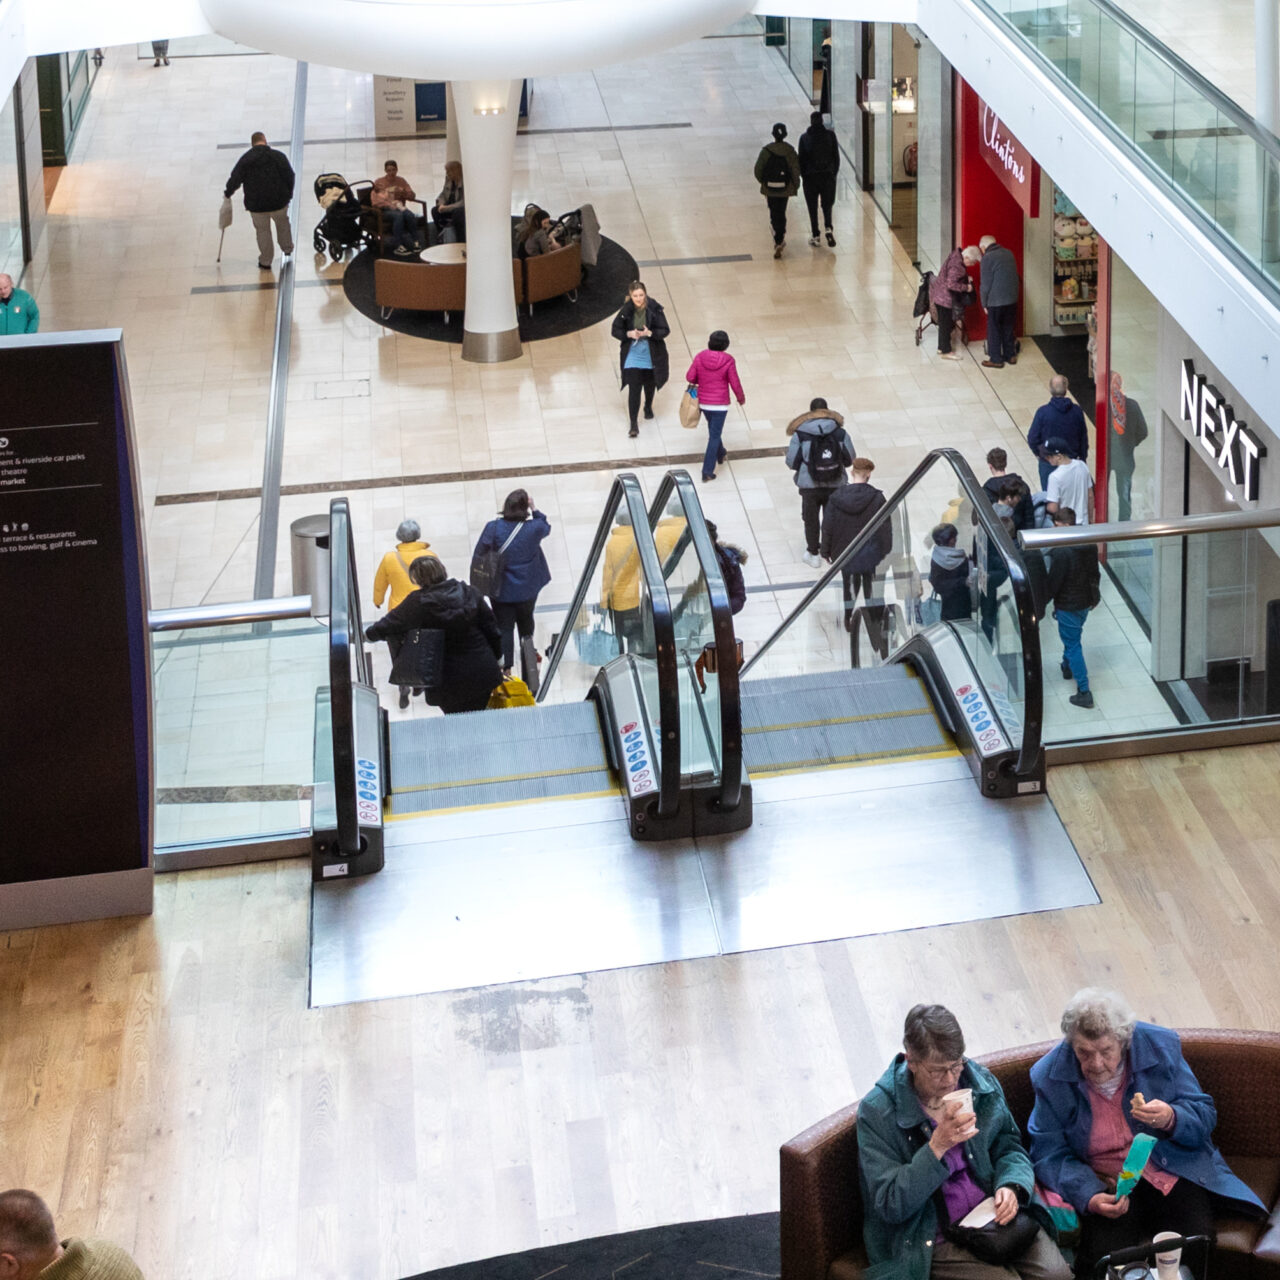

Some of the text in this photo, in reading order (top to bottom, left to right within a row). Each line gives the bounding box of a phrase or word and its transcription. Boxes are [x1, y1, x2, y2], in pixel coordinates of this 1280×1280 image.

[983, 104, 1025, 184] Clintons
[1180, 358, 1267, 502] NEXT
[15, 457, 21, 465] &
[22, 455, 53, 464] riverside
[65, 452, 86, 463] parks
[1, 468, 28, 476] theatre
[0, 478, 26, 486] market
[2, 531, 77, 543] terrace & restaurants
[18, 543, 48, 551] bowling,
[49, 540, 63, 550] golf
[72, 539, 98, 547] cinema
